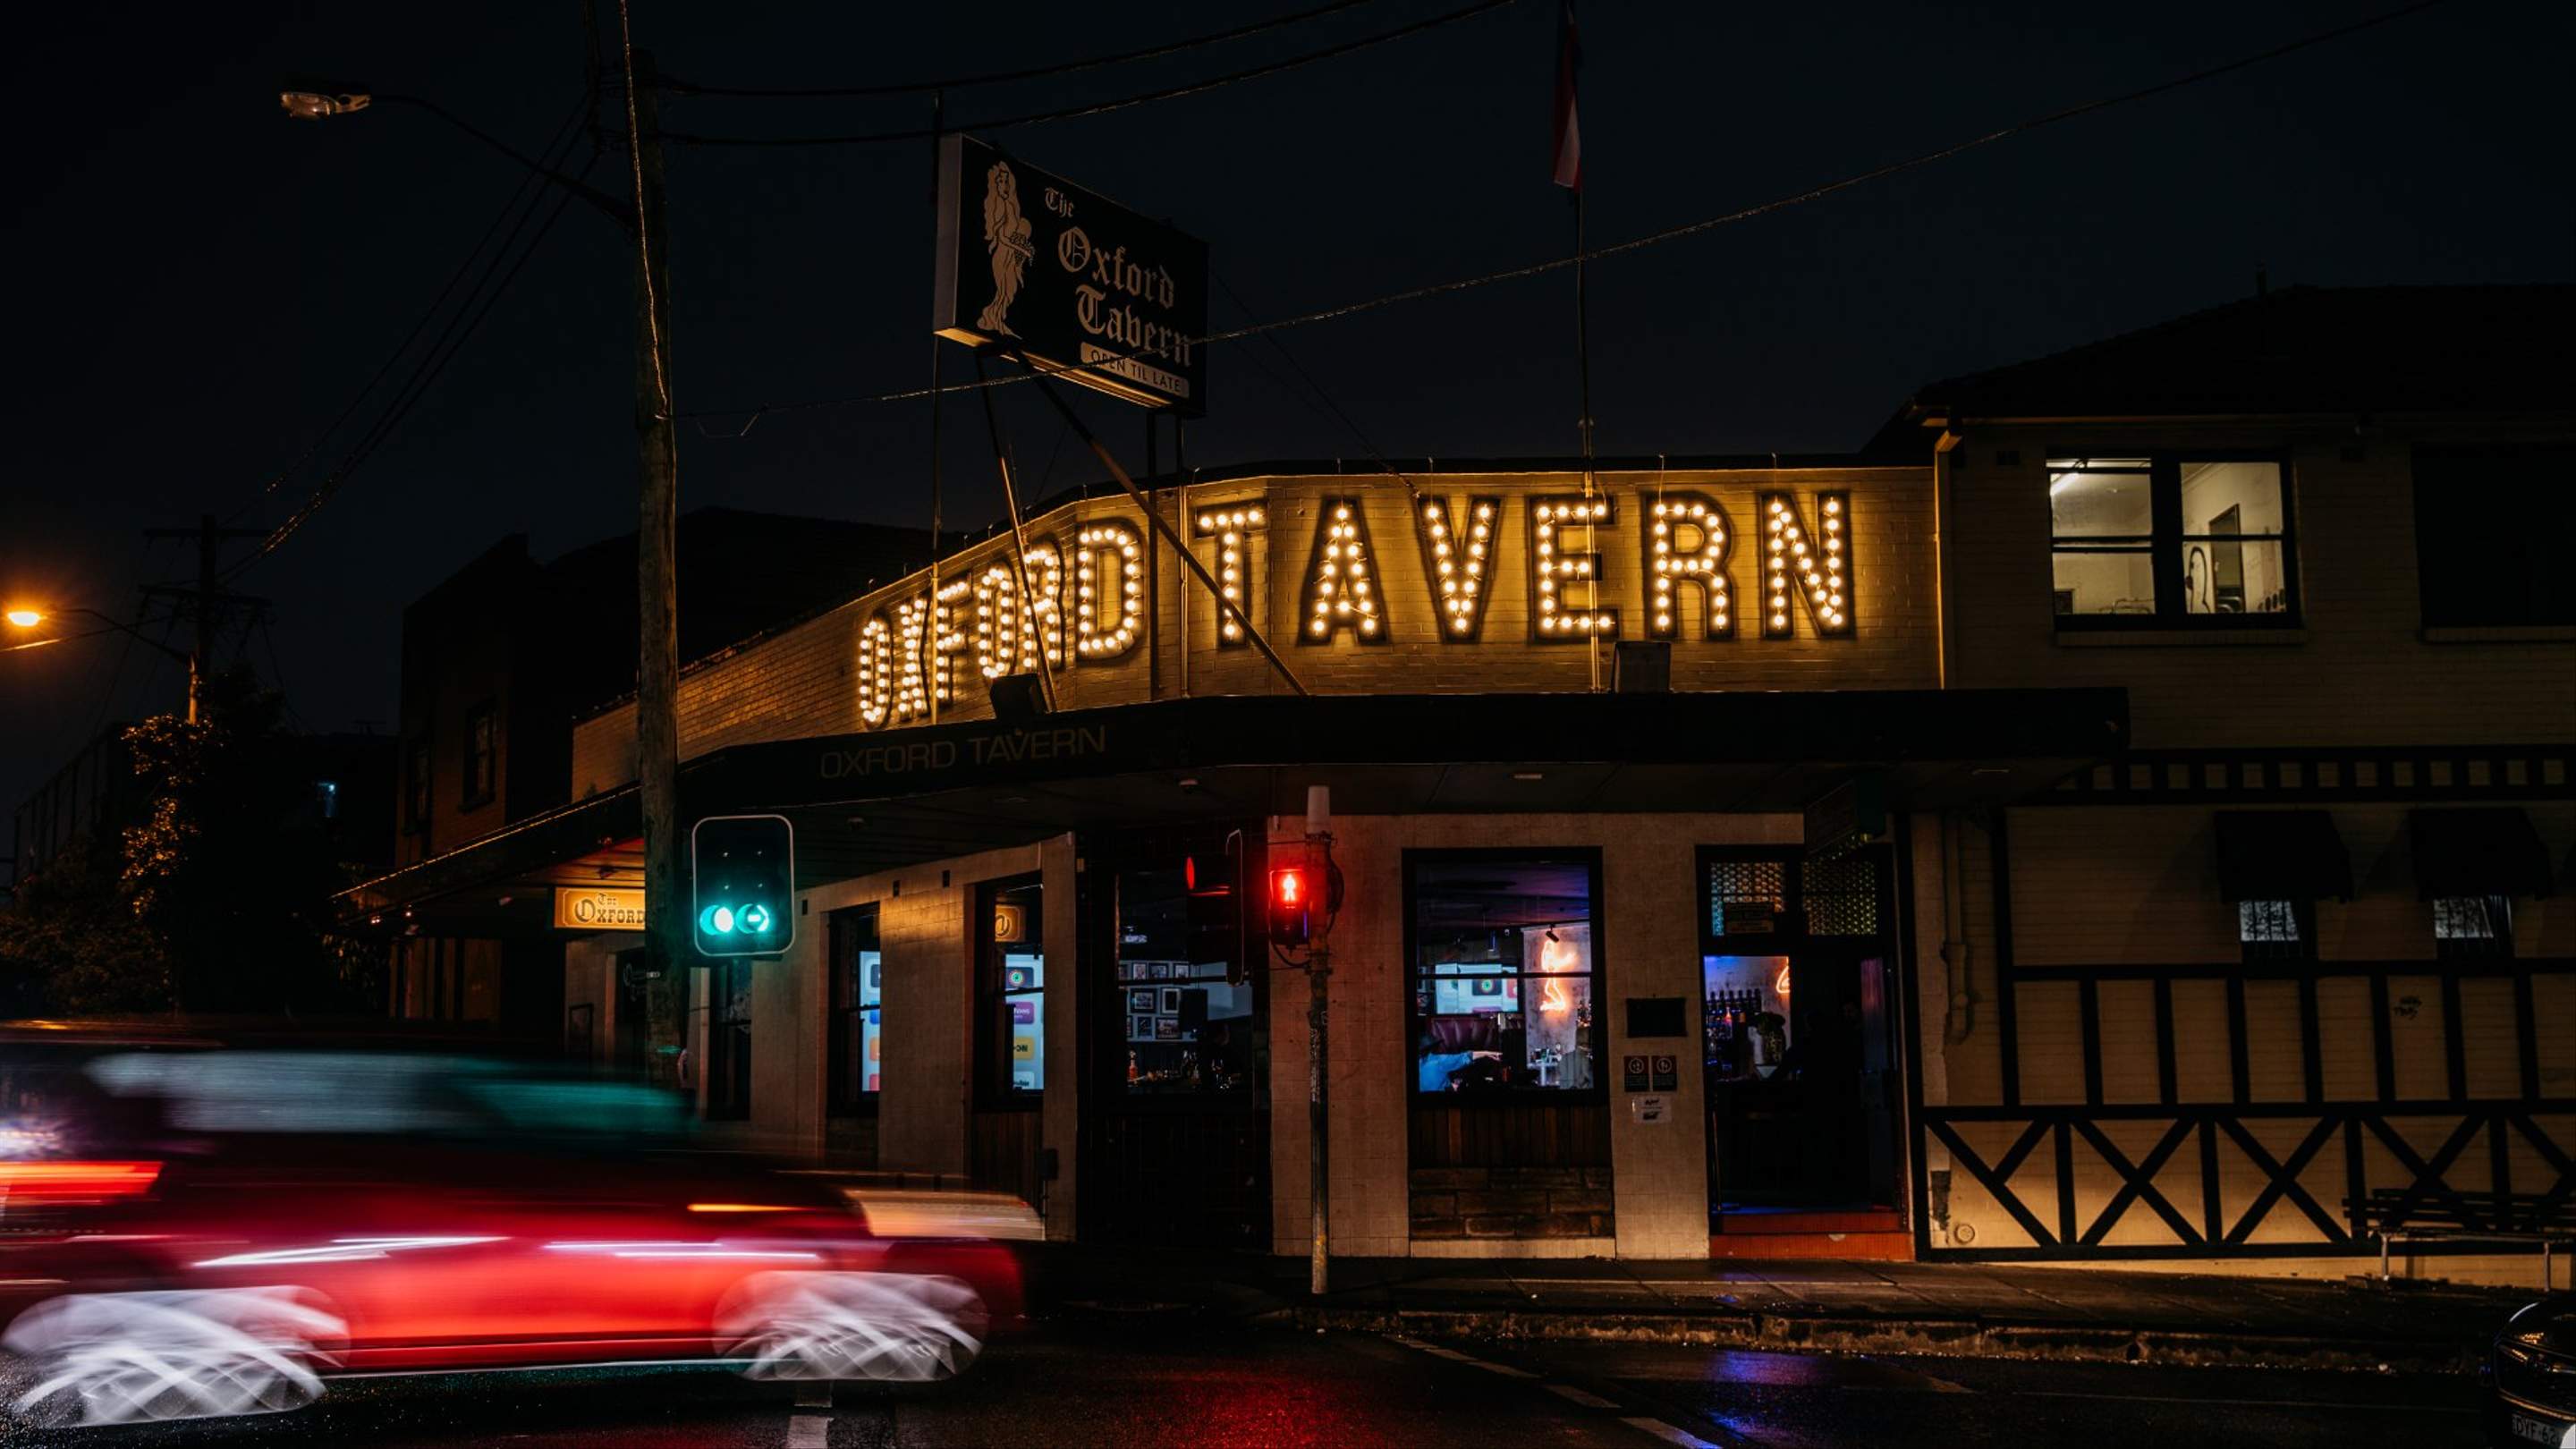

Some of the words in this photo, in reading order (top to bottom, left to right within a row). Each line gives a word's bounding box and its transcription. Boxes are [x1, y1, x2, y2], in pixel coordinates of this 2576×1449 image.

[1044, 186, 1074, 218] The
[1057, 225, 1174, 310] Oxford
[1075, 283, 1193, 369] Tavern
[1090, 349, 1126, 373] OPEN
[1131, 363, 1148, 381] TIL
[1152, 370, 1182, 394] LATE
[856, 516, 1144, 731] OXFORD
[1195, 490, 1857, 648] TAVERN
[820, 740, 956, 780] OXFORD
[967, 724, 1106, 767] TAVERN
